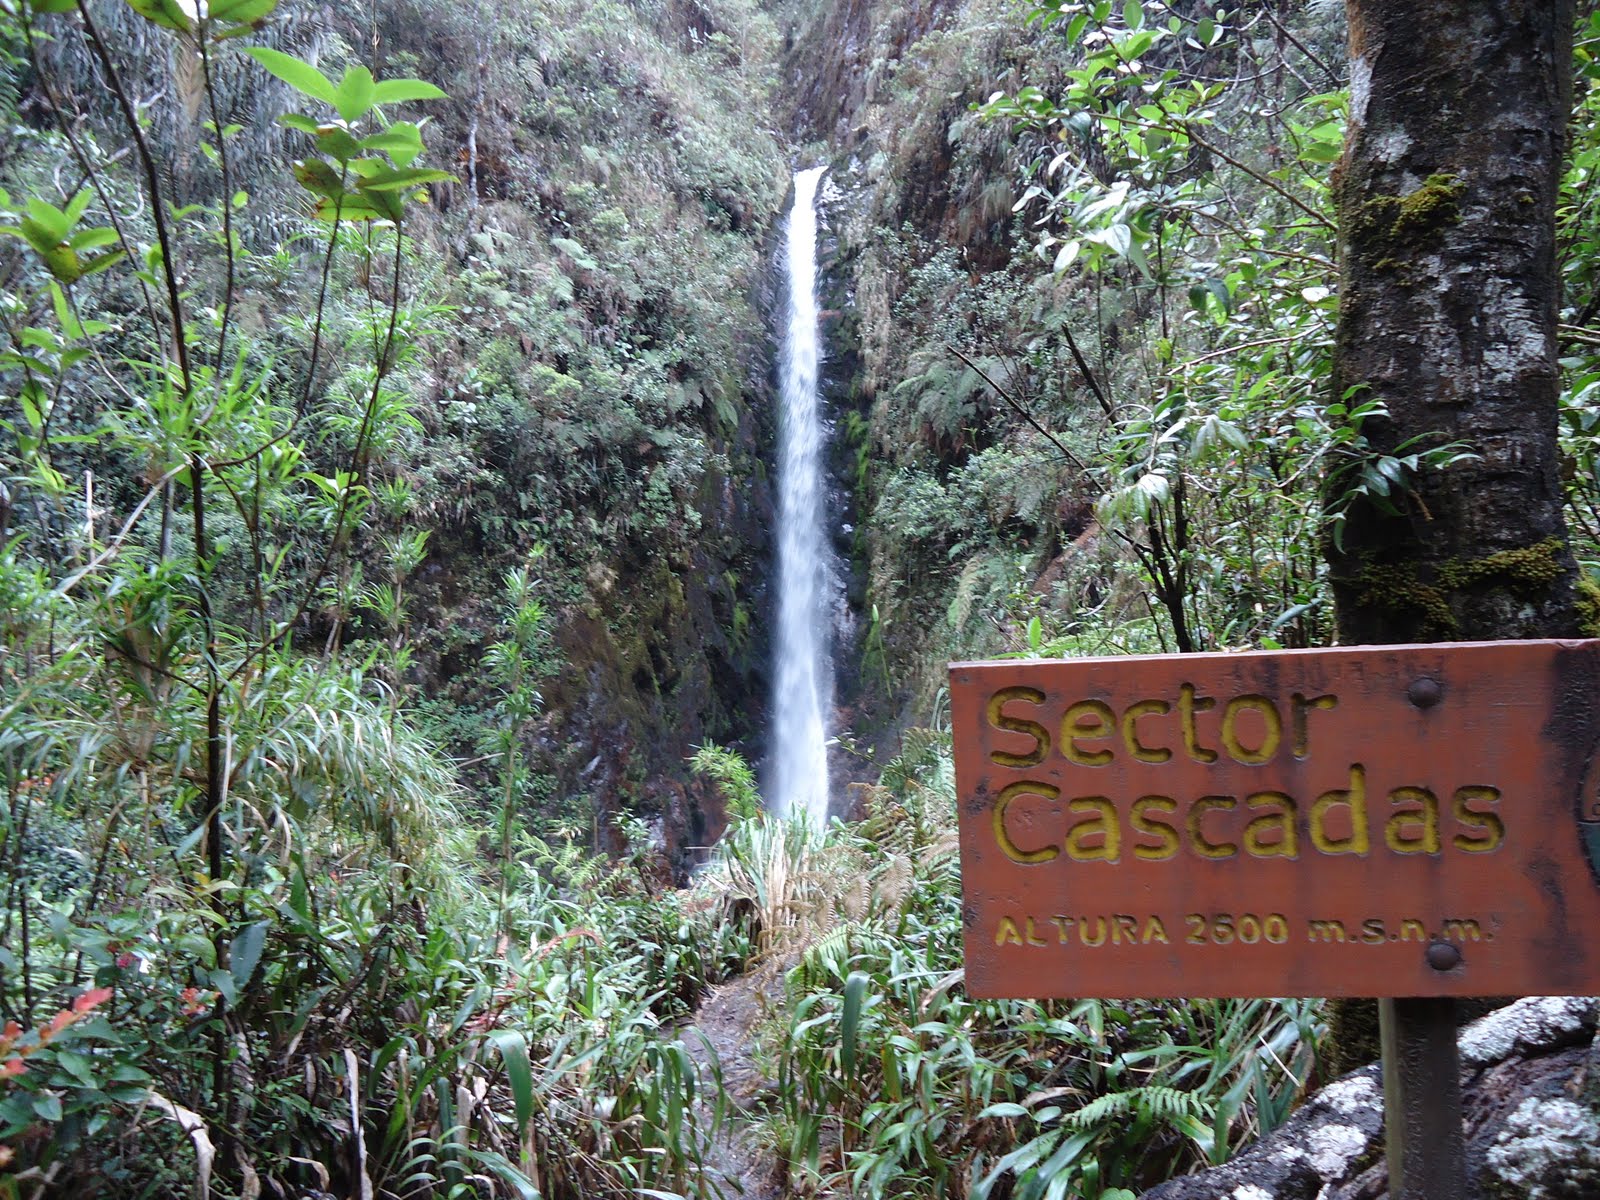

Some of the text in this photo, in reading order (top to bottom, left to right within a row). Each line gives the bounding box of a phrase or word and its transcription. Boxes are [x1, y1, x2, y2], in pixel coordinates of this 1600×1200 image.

[986, 682, 1338, 768] Sector
[993, 763, 1505, 864] Cascadas
[995, 913, 1494, 947] ALTURA 2600 m.s.n.m.
